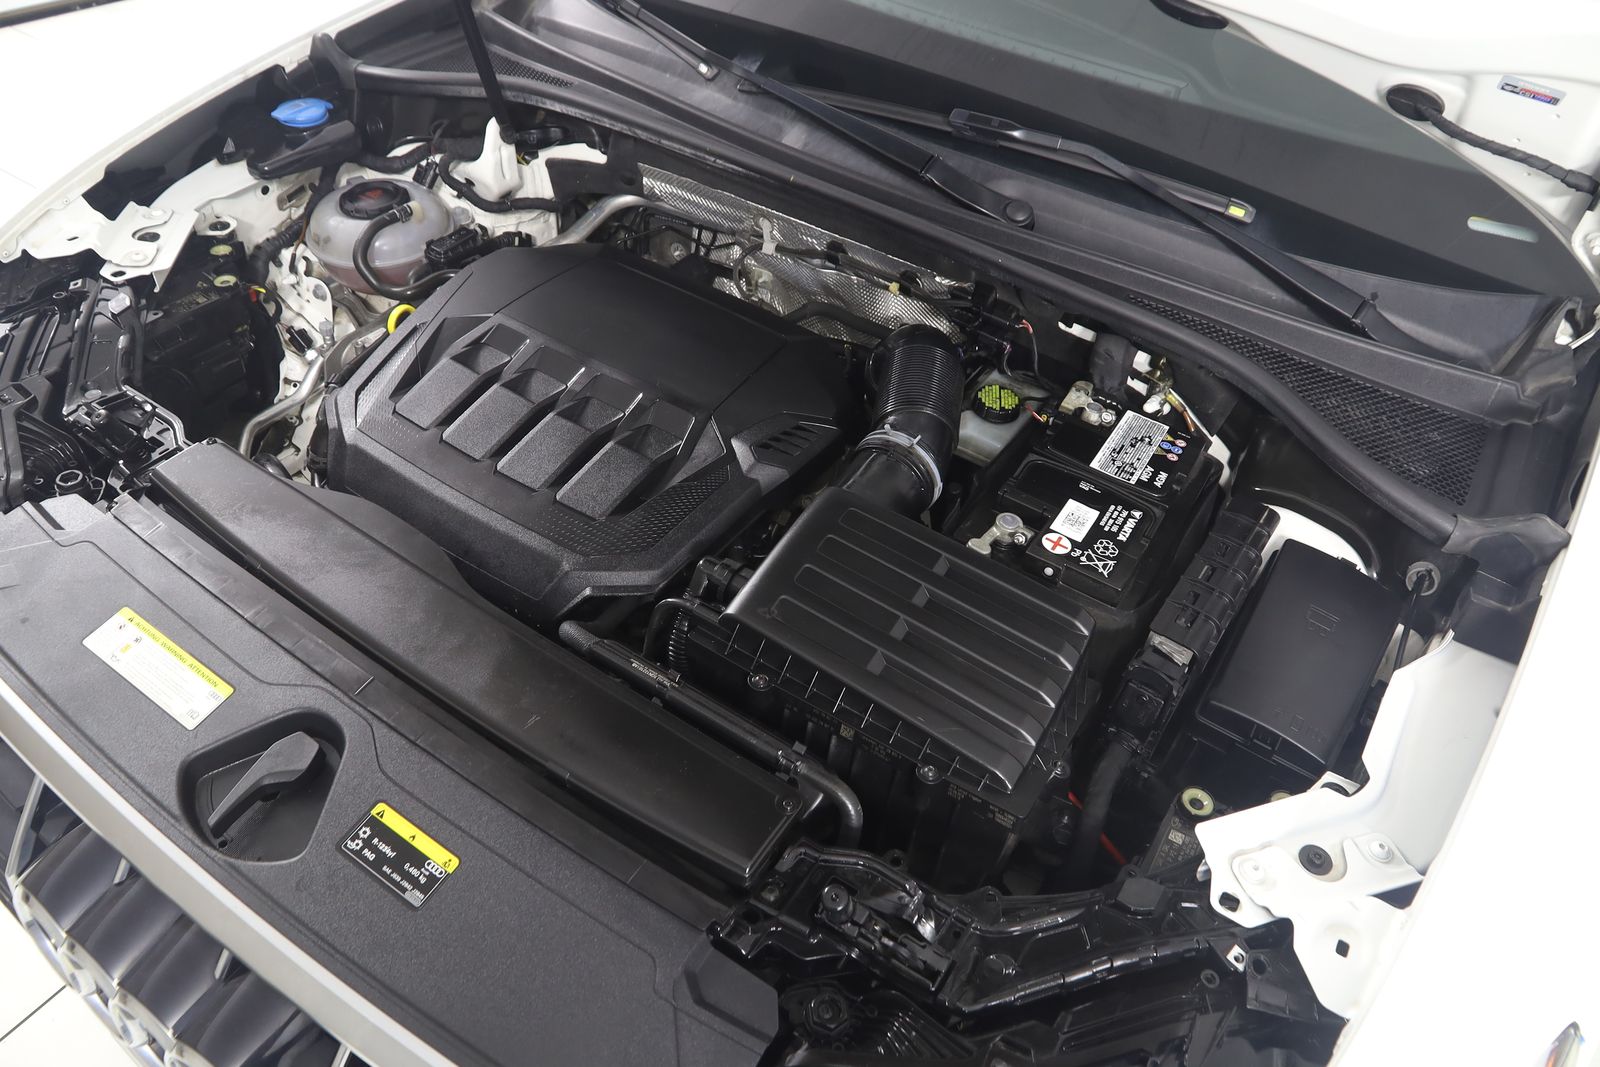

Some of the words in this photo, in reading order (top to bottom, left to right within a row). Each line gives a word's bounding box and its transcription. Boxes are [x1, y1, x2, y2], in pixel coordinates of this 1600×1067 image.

[1140, 465, 1155, 482] AGM
[1154, 471, 1168, 488] AGM
[1117, 518, 1138, 542] VARTA
[135, 622, 160, 642] ACHTUNG
[161, 641, 186, 664] WARNING
[188, 663, 219, 688] ATTENTION
[371, 837, 397, 858] R-1234yf
[418, 874, 427, 884] kg
